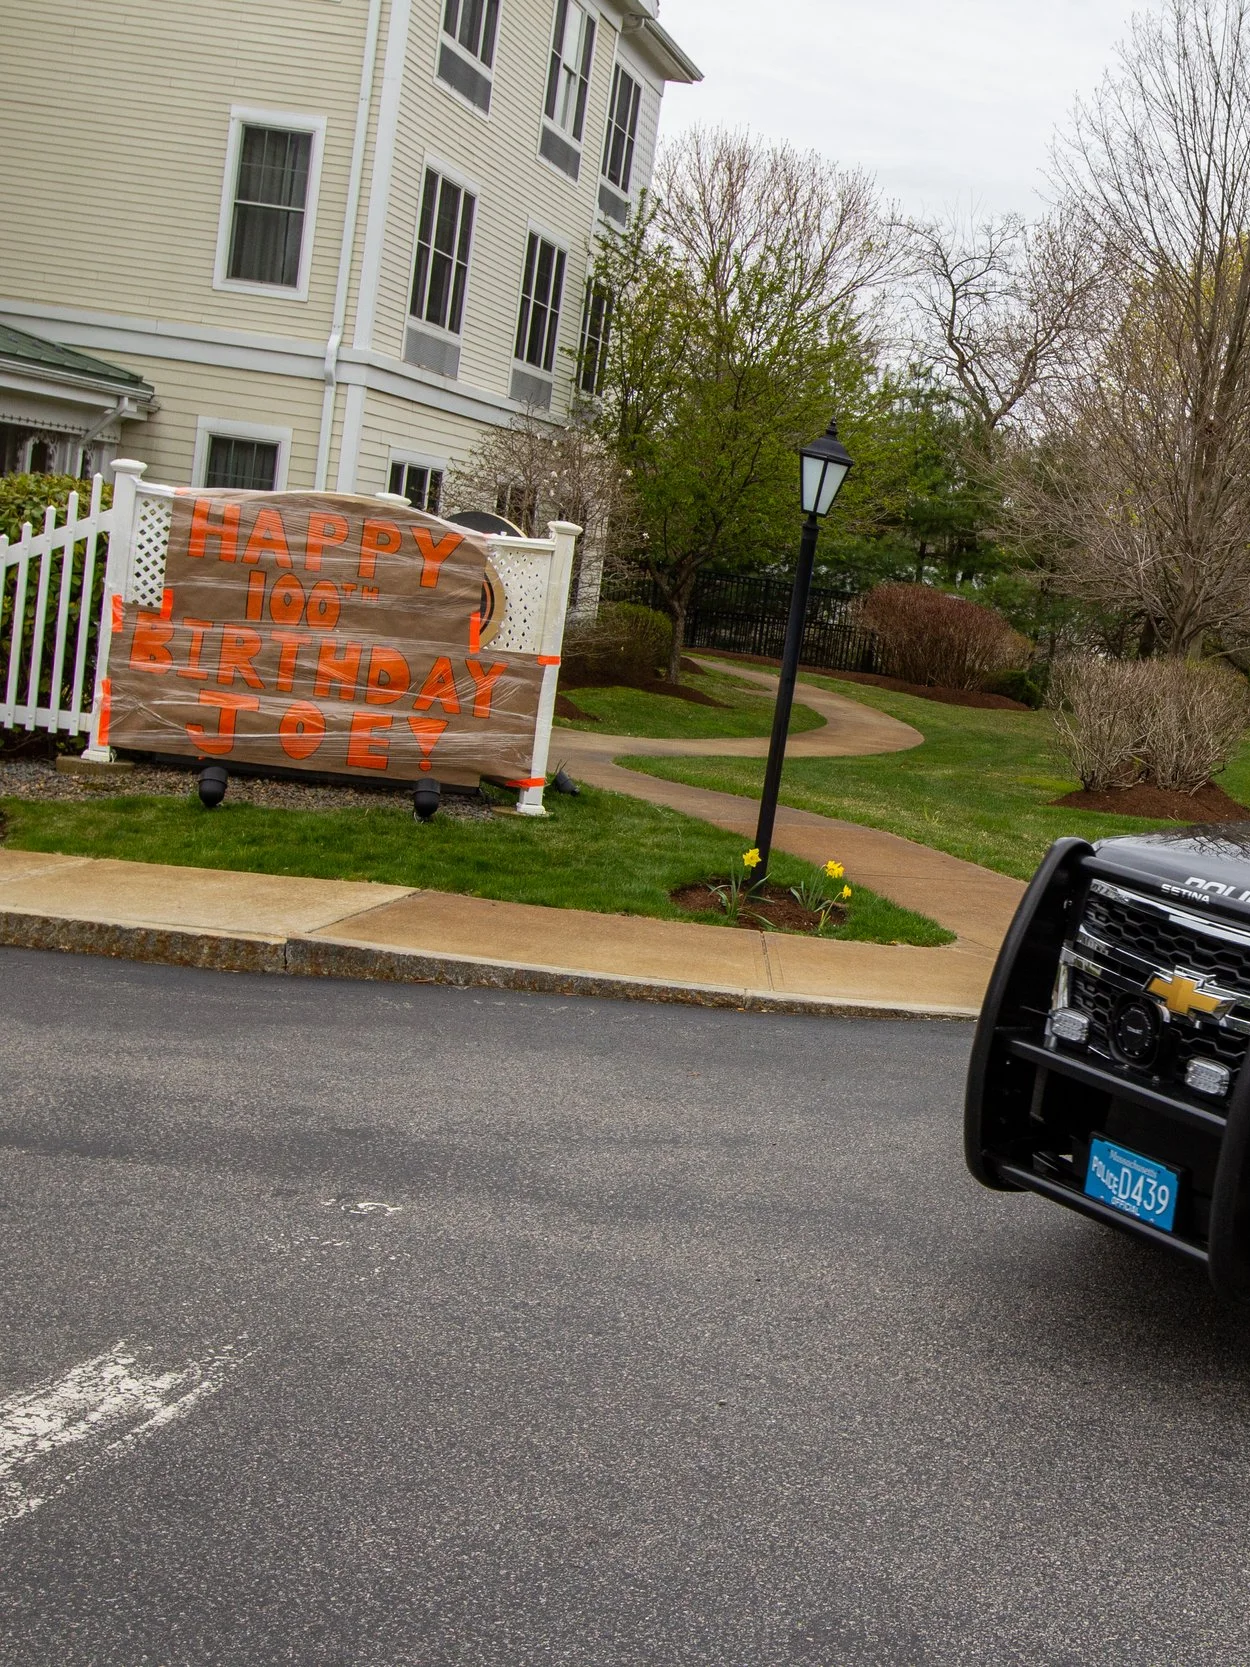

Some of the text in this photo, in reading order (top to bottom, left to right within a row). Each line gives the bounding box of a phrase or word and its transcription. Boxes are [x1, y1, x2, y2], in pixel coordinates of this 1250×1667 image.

[186, 498, 465, 588] HAPPY
[128, 609, 509, 719] BIRTHDAY
[1160, 883, 1210, 905] SETINA
[1092, 1156, 1118, 1195] POLICE
[1119, 1168, 1169, 1214] D439
[1111, 1197, 1140, 1215] OFFICIAL
